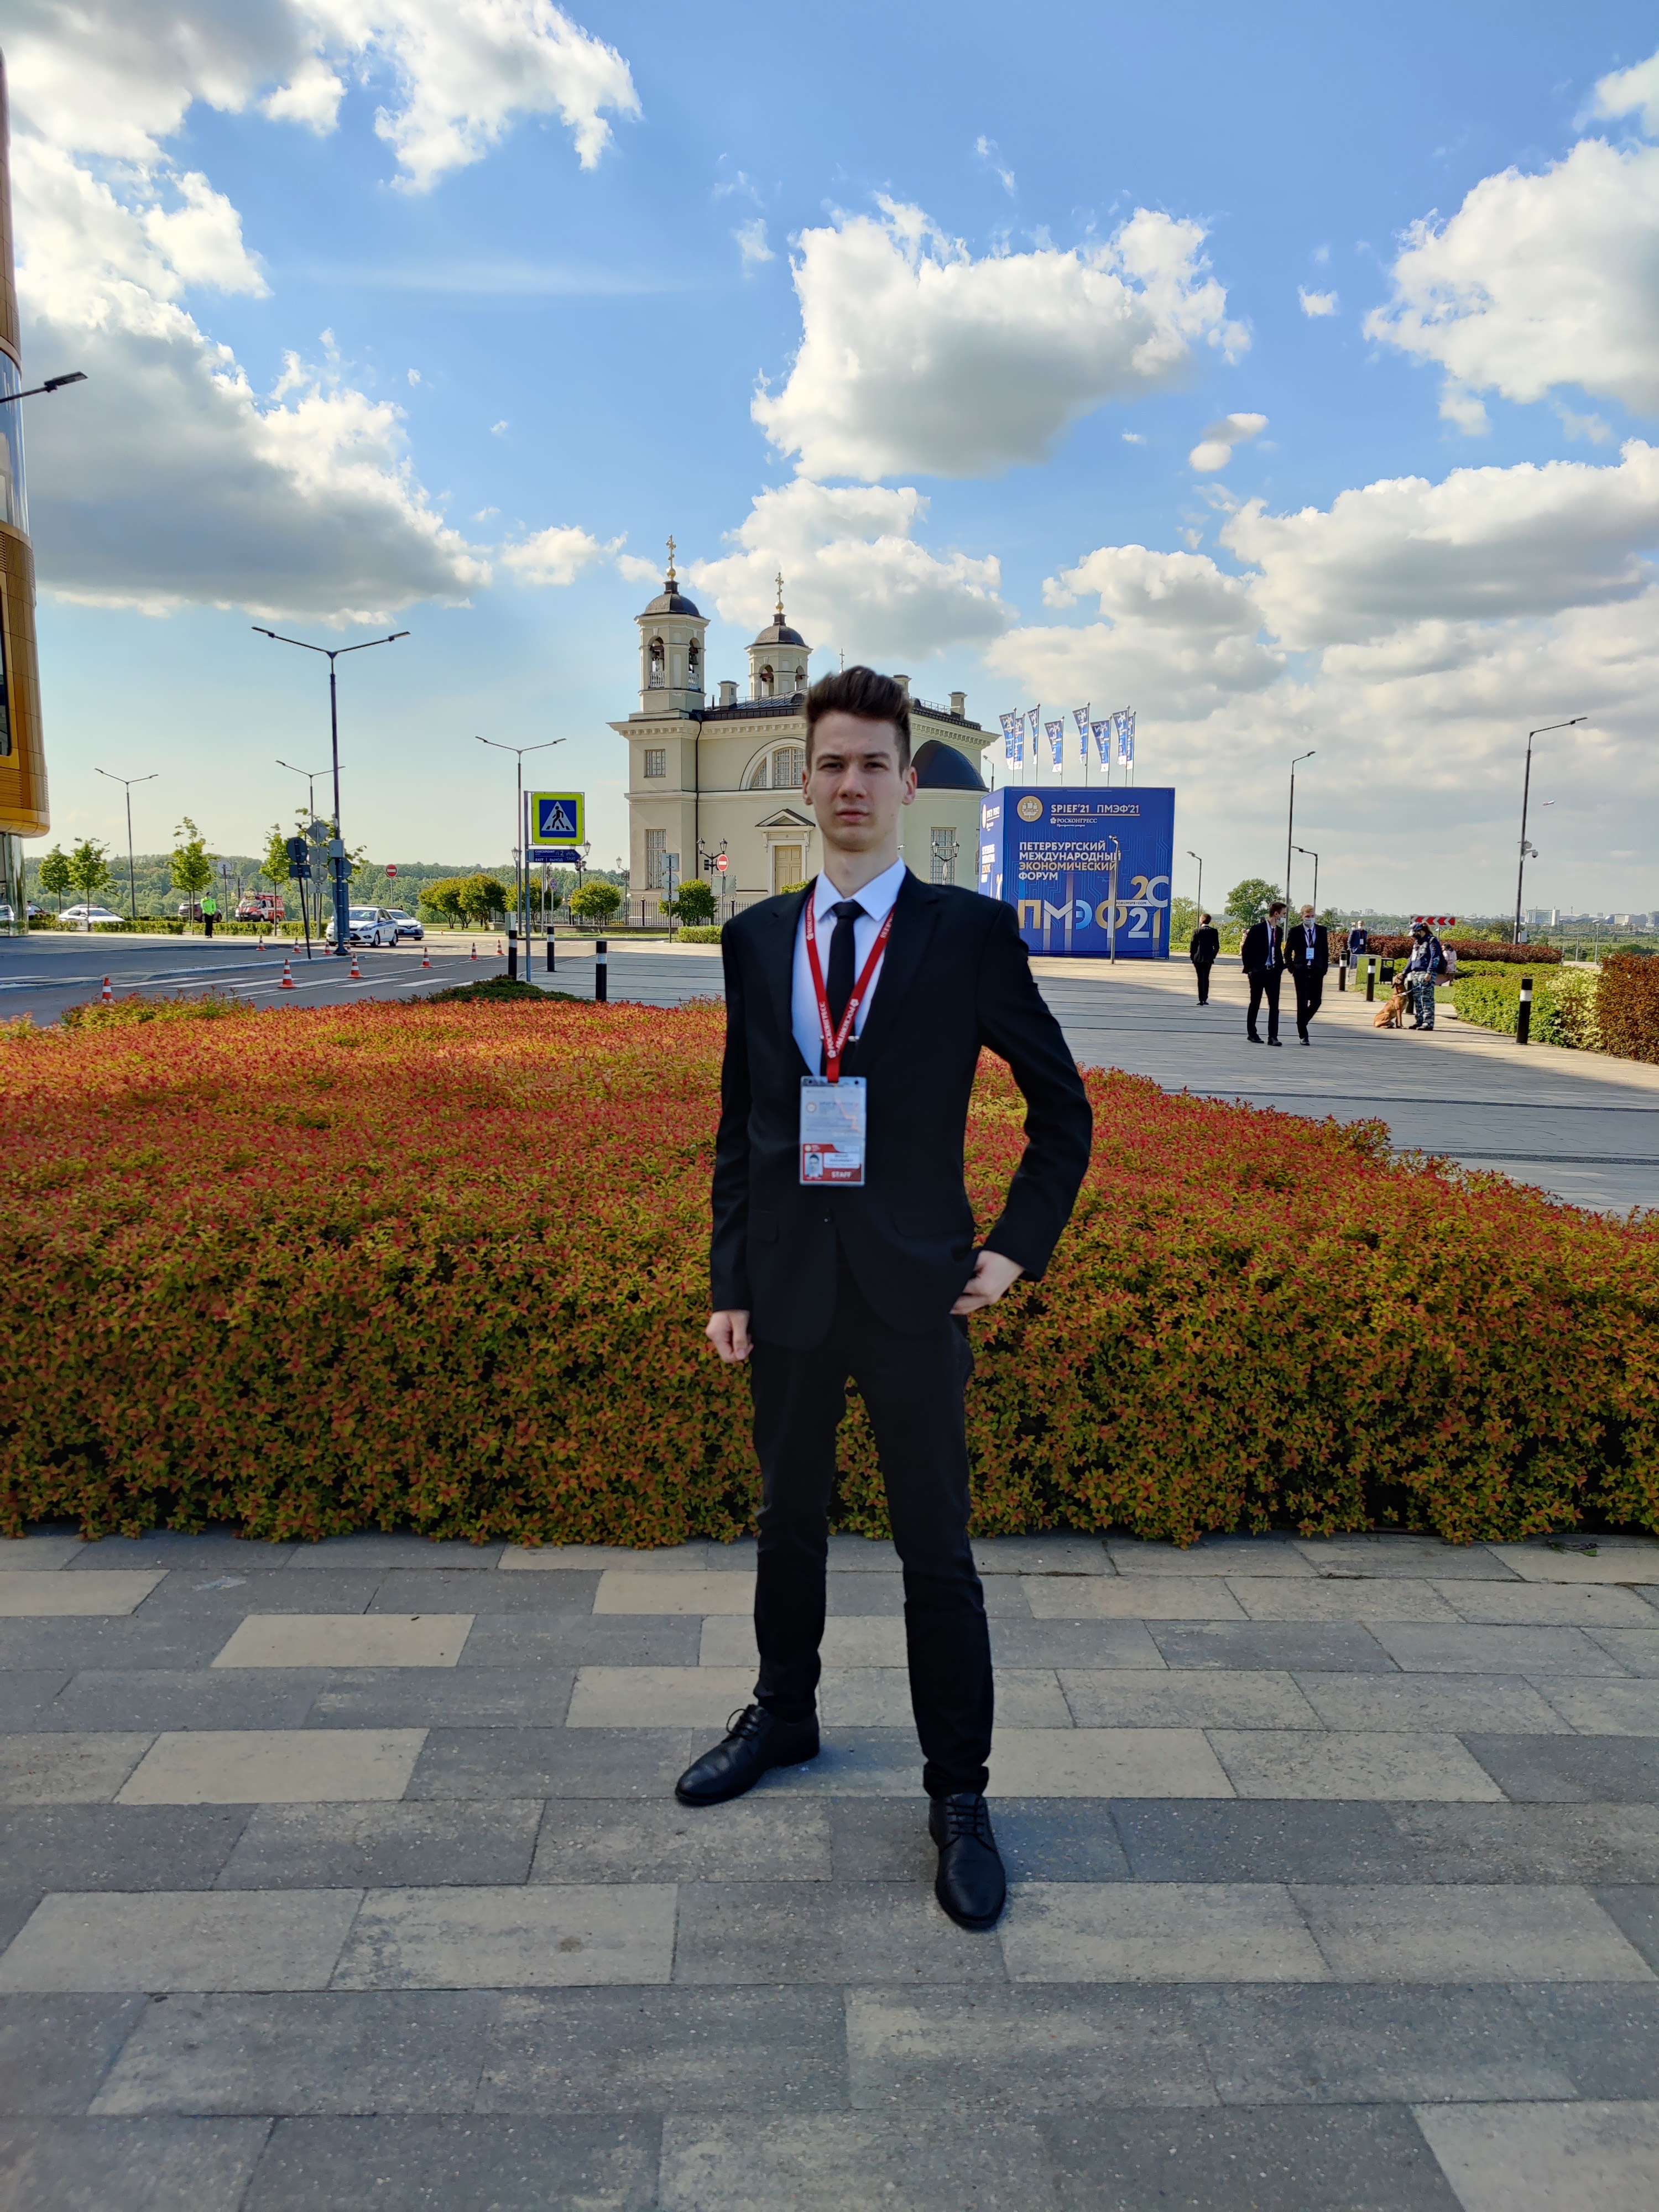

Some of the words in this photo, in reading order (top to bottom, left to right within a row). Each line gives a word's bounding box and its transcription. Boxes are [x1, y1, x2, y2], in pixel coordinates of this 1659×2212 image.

[1019, 840, 1105, 851] ПЕТЕРБУРГСКИЙ
[1019, 850, 1121, 862] МЕЖДУНАРОДНЫЙ
[1019, 860, 1116, 871] ЭКОНОМИЧЕСКИЙ
[1018, 872, 1058, 881] ФОРУМ
[1128, 907, 1161, 938] 21
